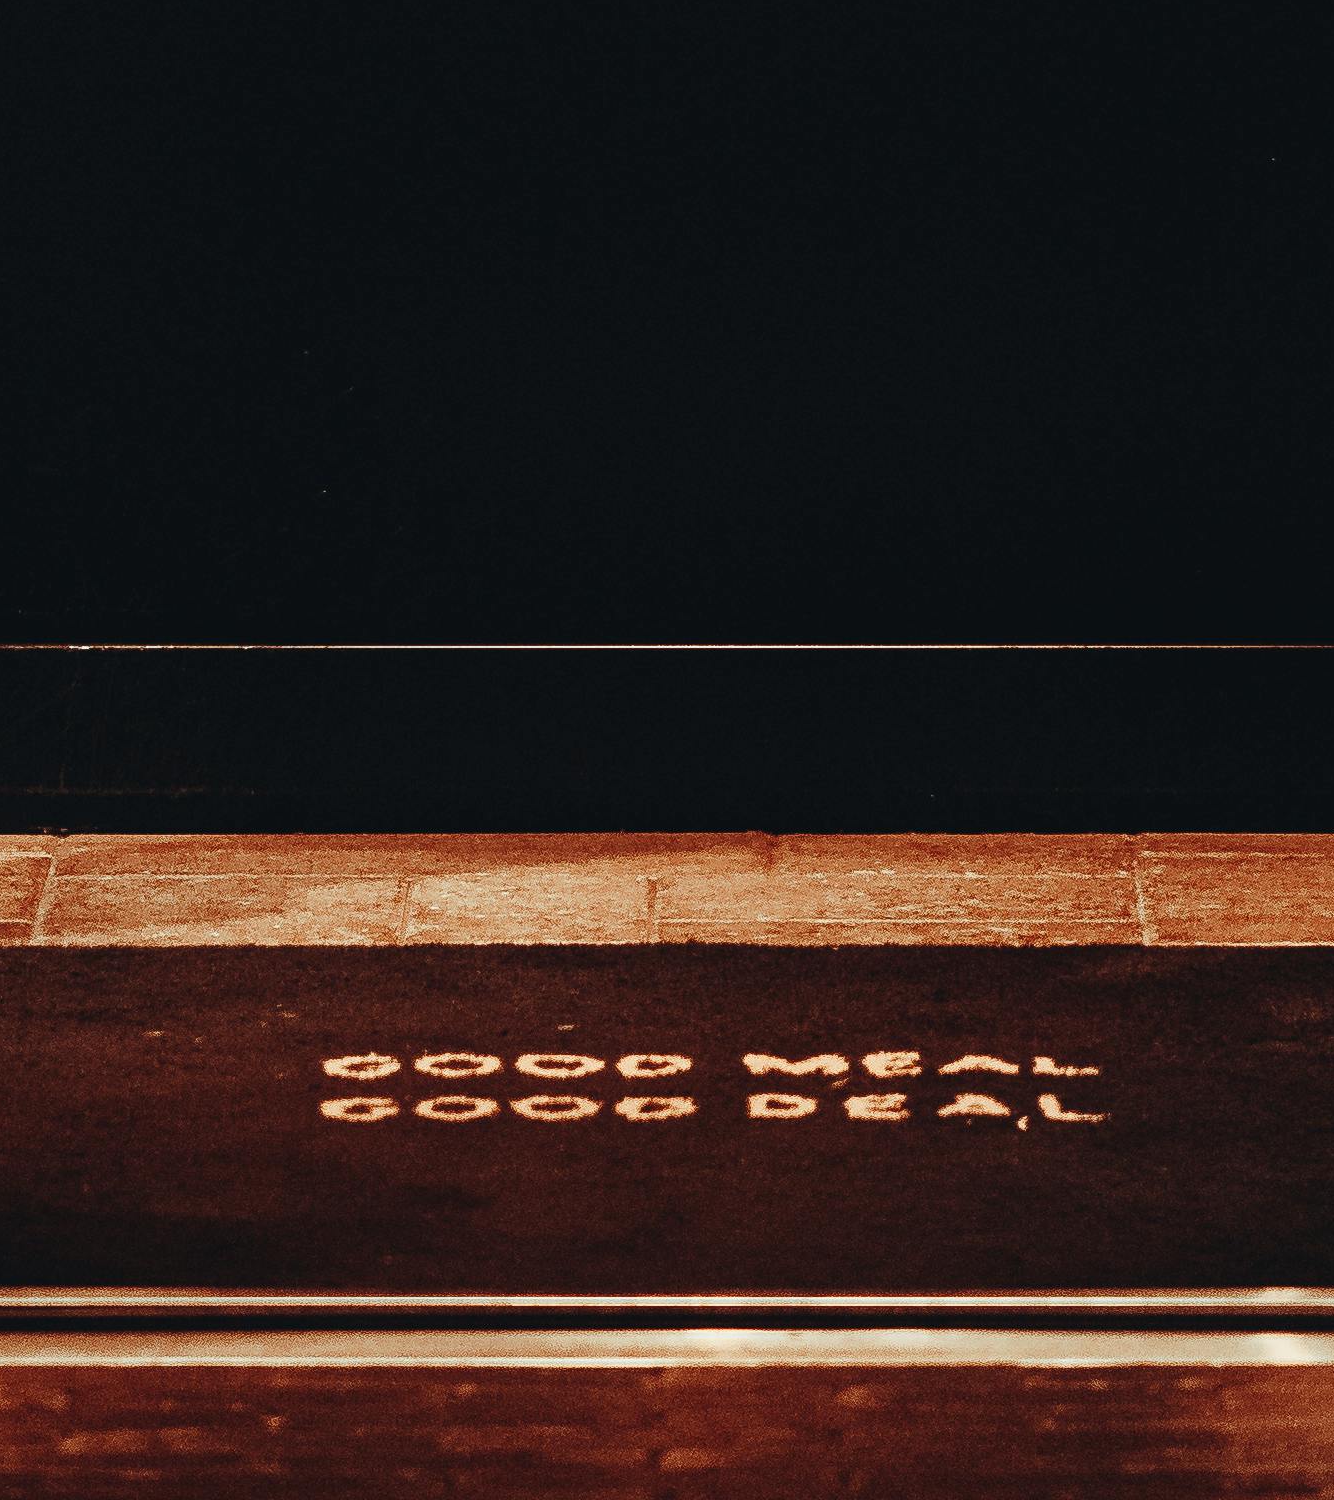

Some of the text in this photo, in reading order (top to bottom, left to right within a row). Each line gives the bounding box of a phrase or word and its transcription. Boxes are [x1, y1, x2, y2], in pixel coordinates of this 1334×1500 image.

[320, 1050, 1101, 1081] GOOD MEAL
[319, 1092, 1105, 1123] GOOD DEAL
